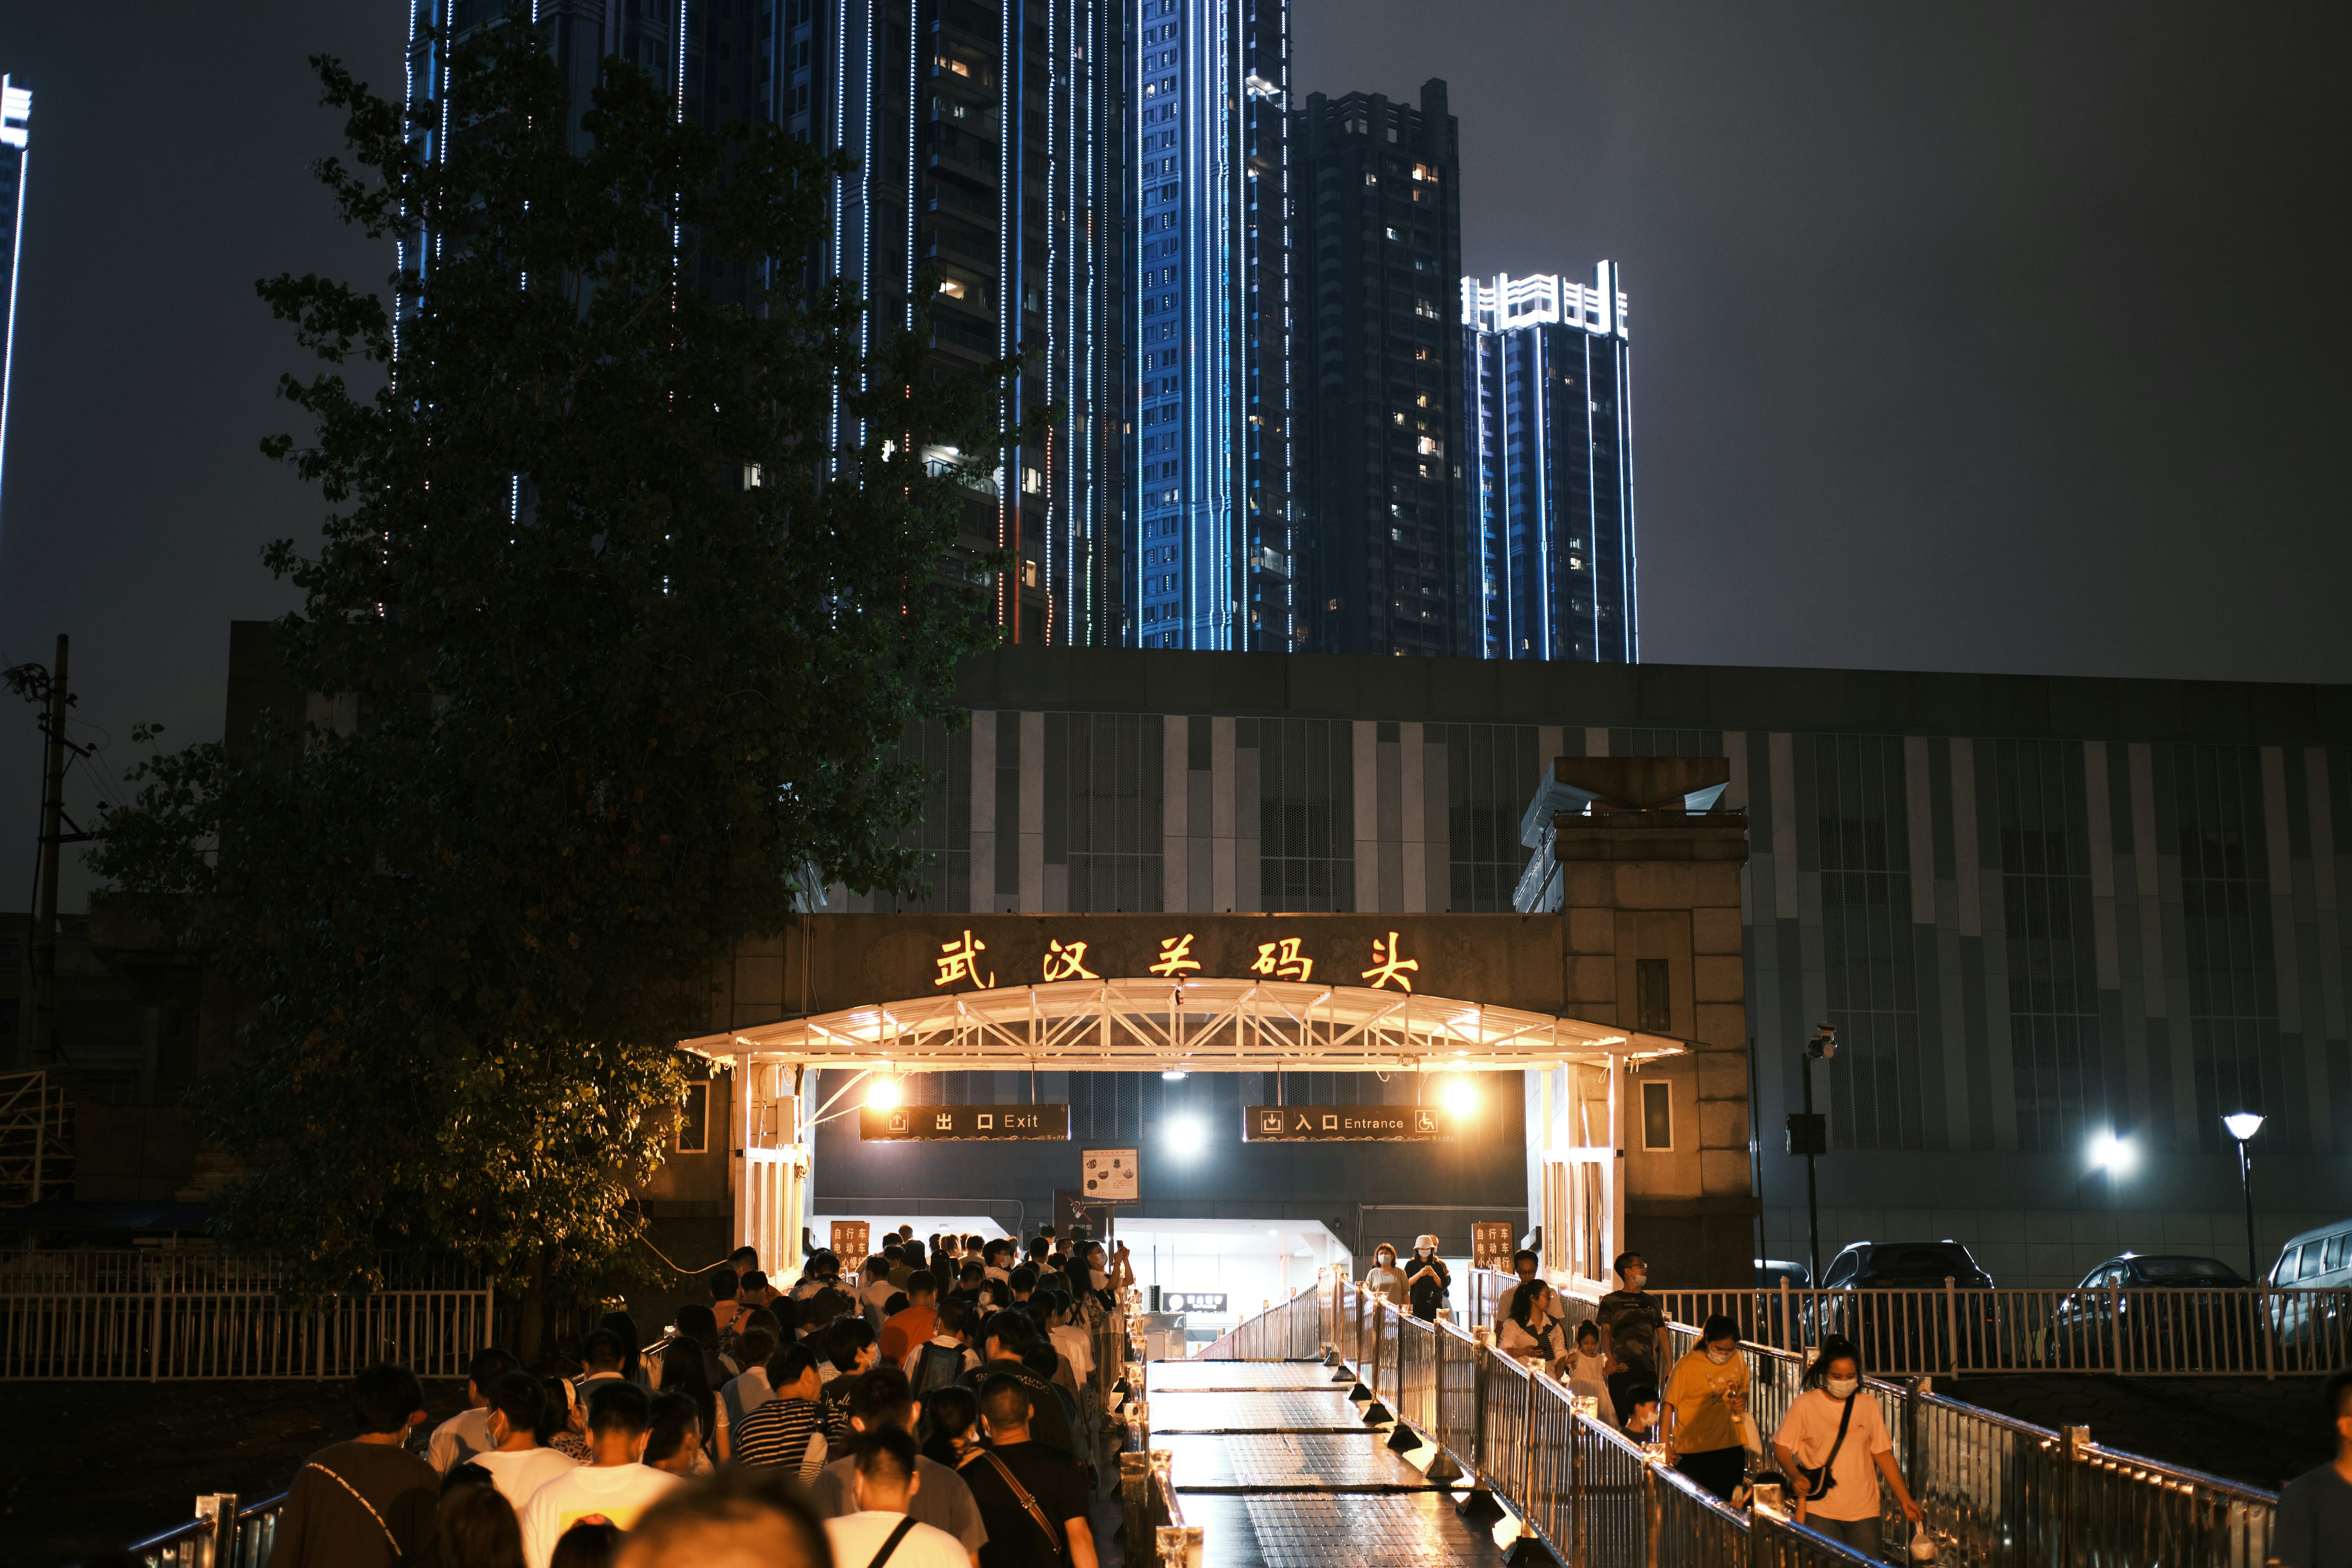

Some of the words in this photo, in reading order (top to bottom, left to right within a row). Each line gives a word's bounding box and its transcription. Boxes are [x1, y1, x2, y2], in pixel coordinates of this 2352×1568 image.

[934, 930, 1418, 992] 武汉关码头
[936, 1113, 993, 1130] 出口
[1005, 1114, 1038, 1128] Exit
[1296, 1114, 1338, 1130] 入口
[1345, 1118, 1404, 1129] Entrance
[835, 1227, 866, 1240] 自行车
[1477, 1228, 1509, 1240] 自行车
[834, 1242, 866, 1254] 电动车
[1477, 1242, 1509, 1254] 电动车
[1477, 1256, 1510, 1269] 小心慢行
